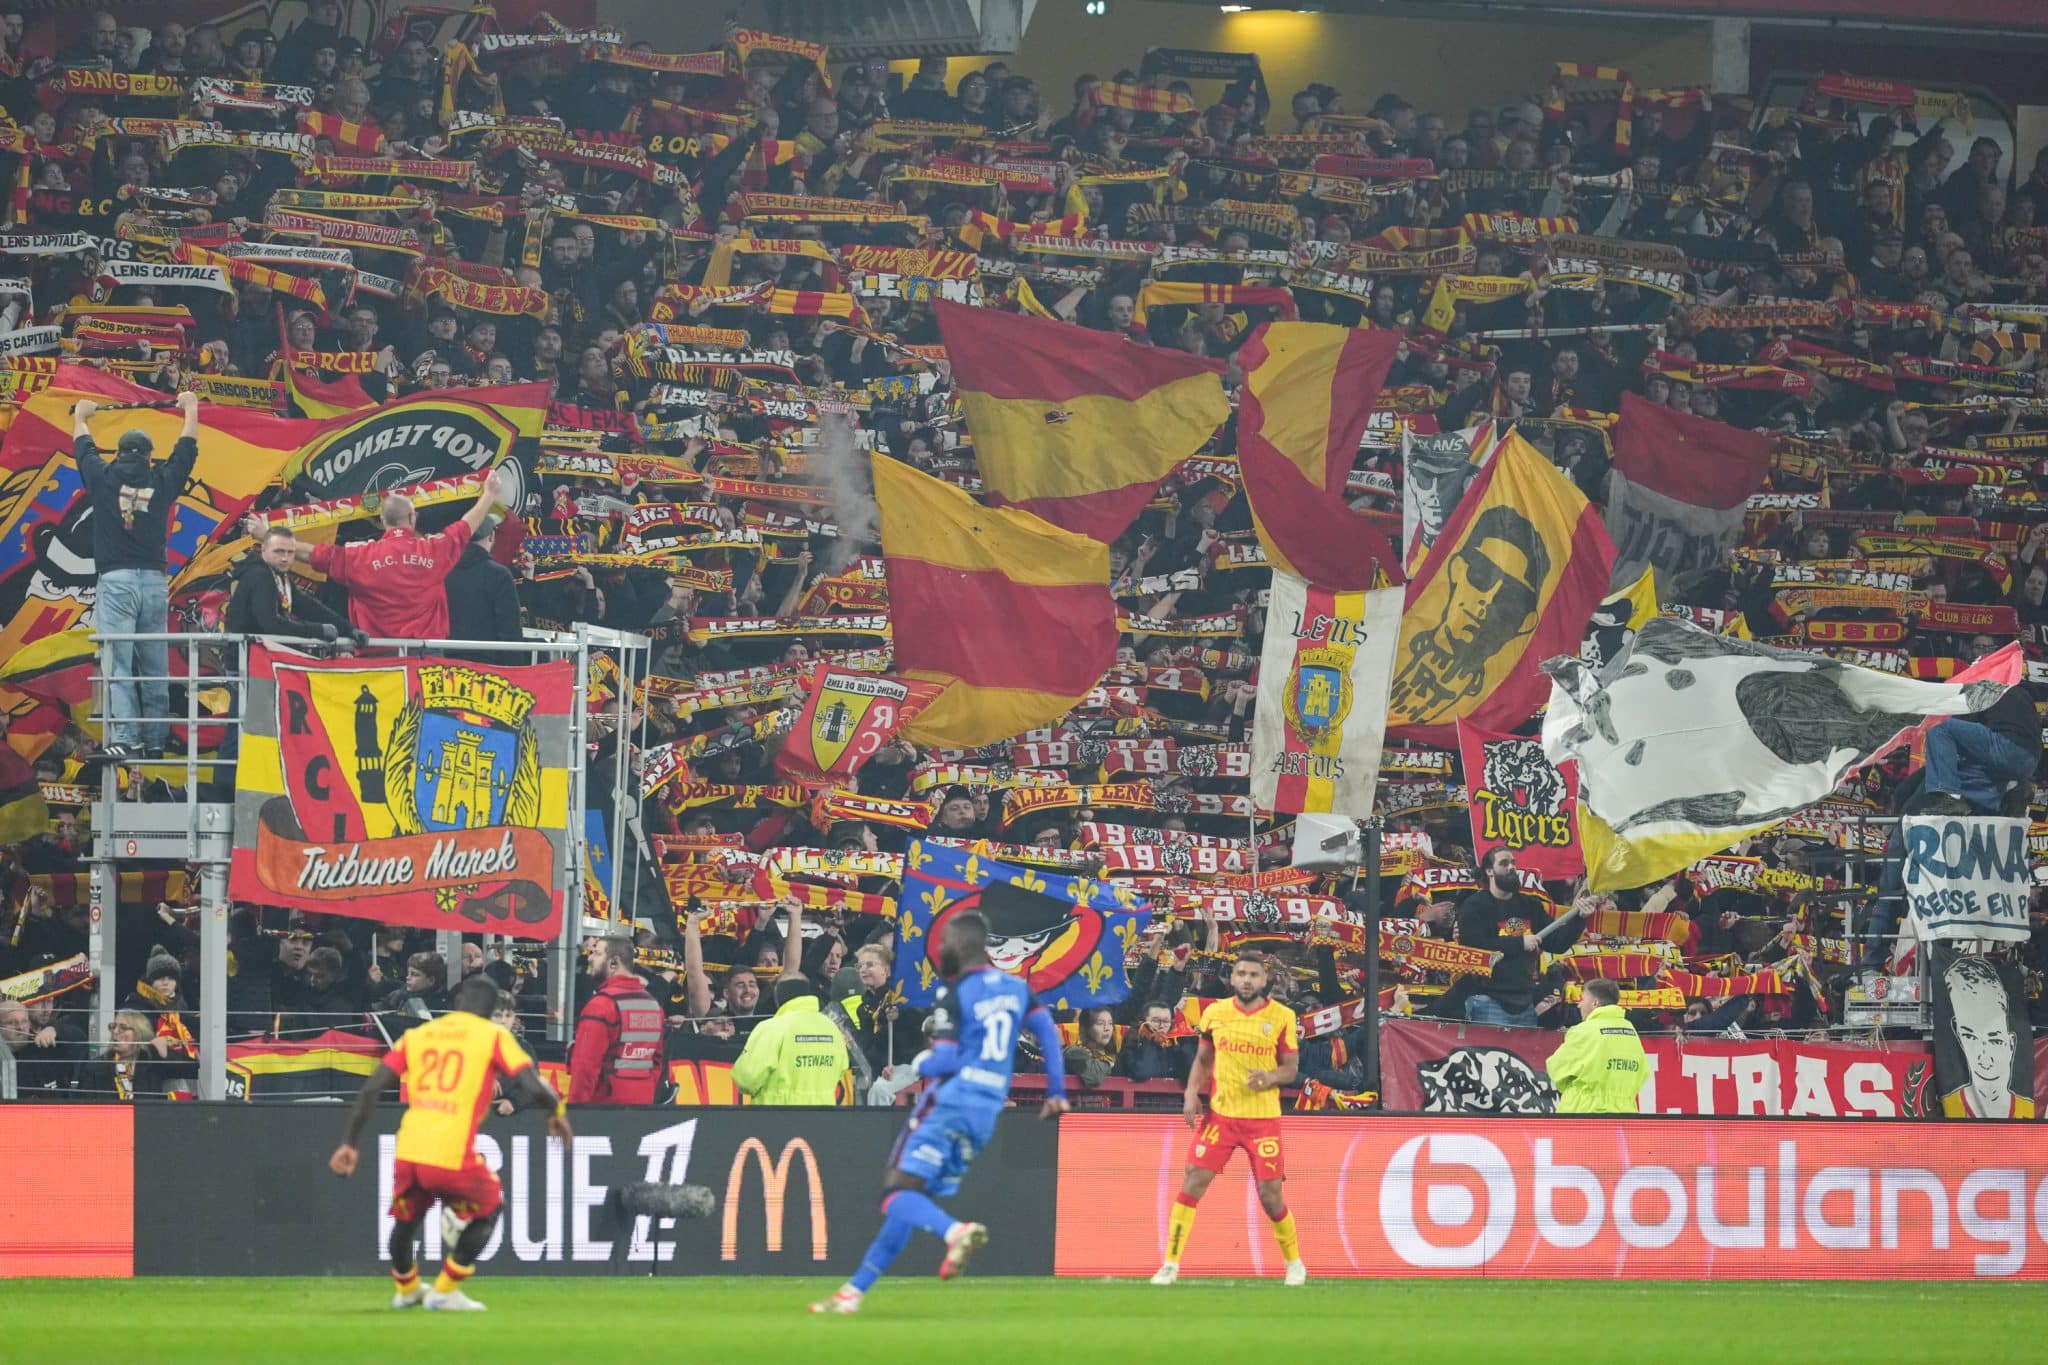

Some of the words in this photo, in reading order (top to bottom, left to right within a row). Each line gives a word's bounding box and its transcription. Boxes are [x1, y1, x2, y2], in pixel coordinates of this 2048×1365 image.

[67, 69, 128, 90] SANG
[1844, 77, 1893, 92] AUCHAN
[649, 136, 664, 153] &
[668, 136, 699, 157] OR
[0, 235, 31, 249] LENS
[33, 234, 85, 249] CAPITALE
[750, 240, 767, 252] RC
[770, 240, 802, 254] LENS
[110, 265, 150, 279] LENS
[152, 264, 219, 282] CAPITALE
[465, 282, 548, 314] LENS
[738, 350, 796, 368] LENS
[208, 380, 251, 399] LENSOIS
[250, 385, 280, 401] POUR
[661, 385, 707, 407] LENS
[1433, 438, 1465, 451] ANS
[556, 455, 614, 474] FANS
[263, 496, 355, 530] LENS
[386, 471, 483, 504] FANS
[735, 482, 809, 499] TIGERS
[1744, 493, 1820, 510] FANS
[371, 555, 399, 571] R.C.
[402, 553, 435, 571] LENS
[1773, 565, 1817, 583] ENS
[1848, 569, 1913, 592] FANS
[709, 618, 777, 633] LENS
[817, 616, 889, 632] FANS
[1290, 609, 1369, 648] LENS
[1934, 611, 1959, 624] CLUB
[1972, 612, 1994, 625] LENS
[1811, 621, 1900, 640] JSO
[286, 690, 313, 736] R
[1023, 741, 1070, 769] 19
[1226, 751, 1252, 777] 9
[1394, 751, 1447, 769] FANS
[304, 754, 332, 801] C
[843, 799, 917, 817] ENS
[1002, 785, 1070, 822] ALLEZ
[1101, 784, 1154, 803] LENS
[1475, 788, 1572, 849] Tigers
[1084, 821, 1126, 846] 19
[298, 843, 413, 889] Tribune
[424, 830, 519, 881] Marek
[1108, 845, 1156, 872] 19
[1197, 847, 1245, 875] 94
[669, 880, 710, 897] ED
[1255, 867, 1308, 888] TIGERS
[1286, 898, 1341, 924] 94
[1986, 888, 2014, 918] EN
[1422, 942, 1485, 967] TIGERS
[979, 1010, 1014, 1063] 10
[1218, 1036, 1273, 1058] Auchan
[416, 1049, 465, 1093] 20
[796, 1055, 834, 1068] STEWARD
[1638, 1052, 1895, 1117] LTRAS
[1200, 1123, 1221, 1146] 14
[1533, 1137, 2048, 1277] boulang
